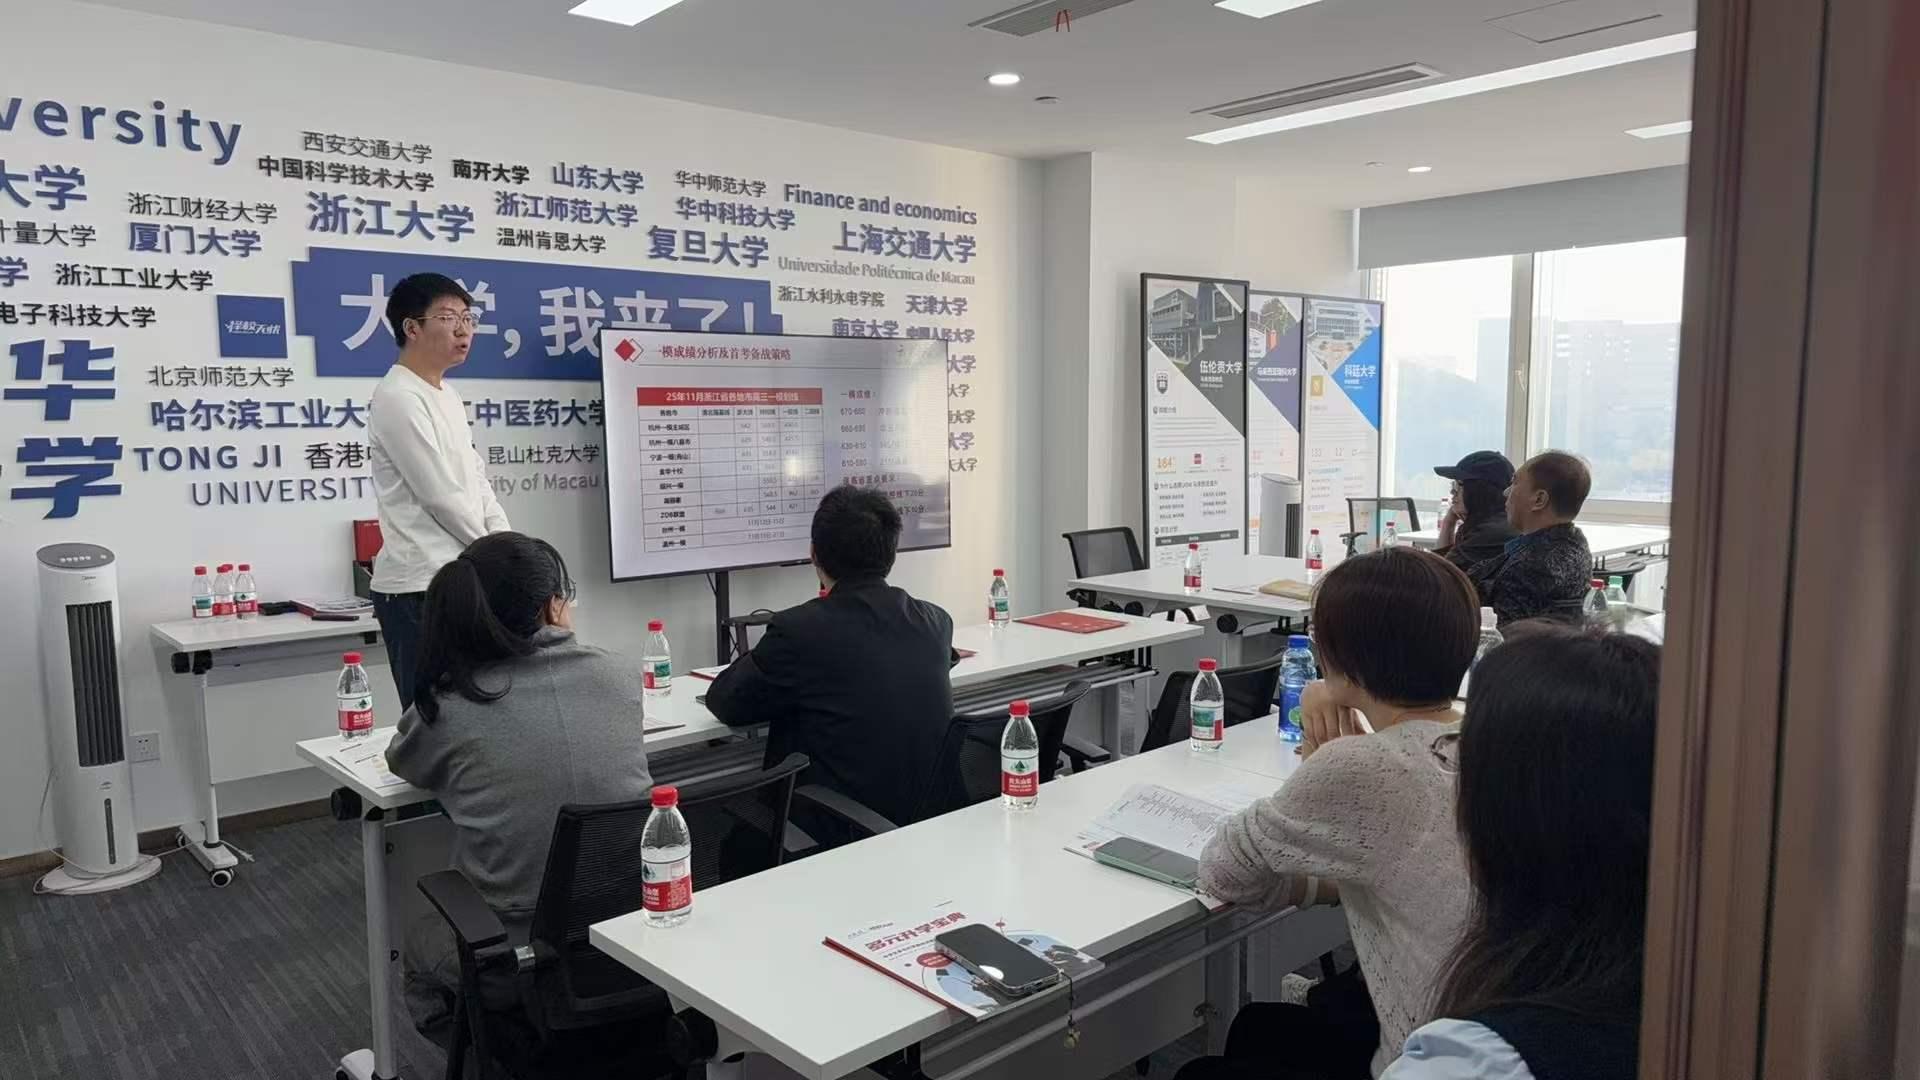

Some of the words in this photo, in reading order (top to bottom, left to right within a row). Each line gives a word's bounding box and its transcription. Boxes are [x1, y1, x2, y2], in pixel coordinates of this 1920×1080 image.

[301, 131, 432, 164] 西安交通大学
[258, 155, 435, 192] 中国科学技术大学
[452, 159, 530, 185] 南开大学
[552, 162, 644, 194] 山东大学
[675, 170, 767, 198] 华中师范大学
[127, 192, 278, 225] 浙江财经大学
[306, 191, 475, 242] 浙江大学
[495, 190, 639, 228] 浙江师范大学
[675, 196, 795, 231] 华中科技大学
[784, 184, 854, 210] Finance
[858, 196, 890, 215] and
[894, 203, 977, 225] economics
[128, 221, 262, 258] 厦门大学
[496, 226, 606, 254] 温州肯恩大学
[647, 225, 769, 268] 复旦大学
[832, 221, 976, 263] 上海交通大学
[55, 263, 213, 291] 浙江工业大学
[777, 256, 859, 277] Universidade
[861, 263, 924, 282] Politécnica
[925, 268, 940, 283] de
[941, 271, 975, 285] Macau
[777, 286, 885, 307] 浙江水利水电学院
[905, 294, 968, 316] 天津大学
[0, 301, 156, 328] 电子科技大学
[4, 339, 116, 421] 华
[147, 365, 294, 388] 北京师范大学
[150, 398, 371, 432] 哈尔滨工业大
[134, 446, 238, 471] TONG
[253, 445, 281, 467] JI
[488, 444, 600, 465] 昆山杜克大学
[11, 437, 123, 519] 学
[191, 477, 373, 506] UNIVERSIT
[543, 474, 598, 491] Macau
